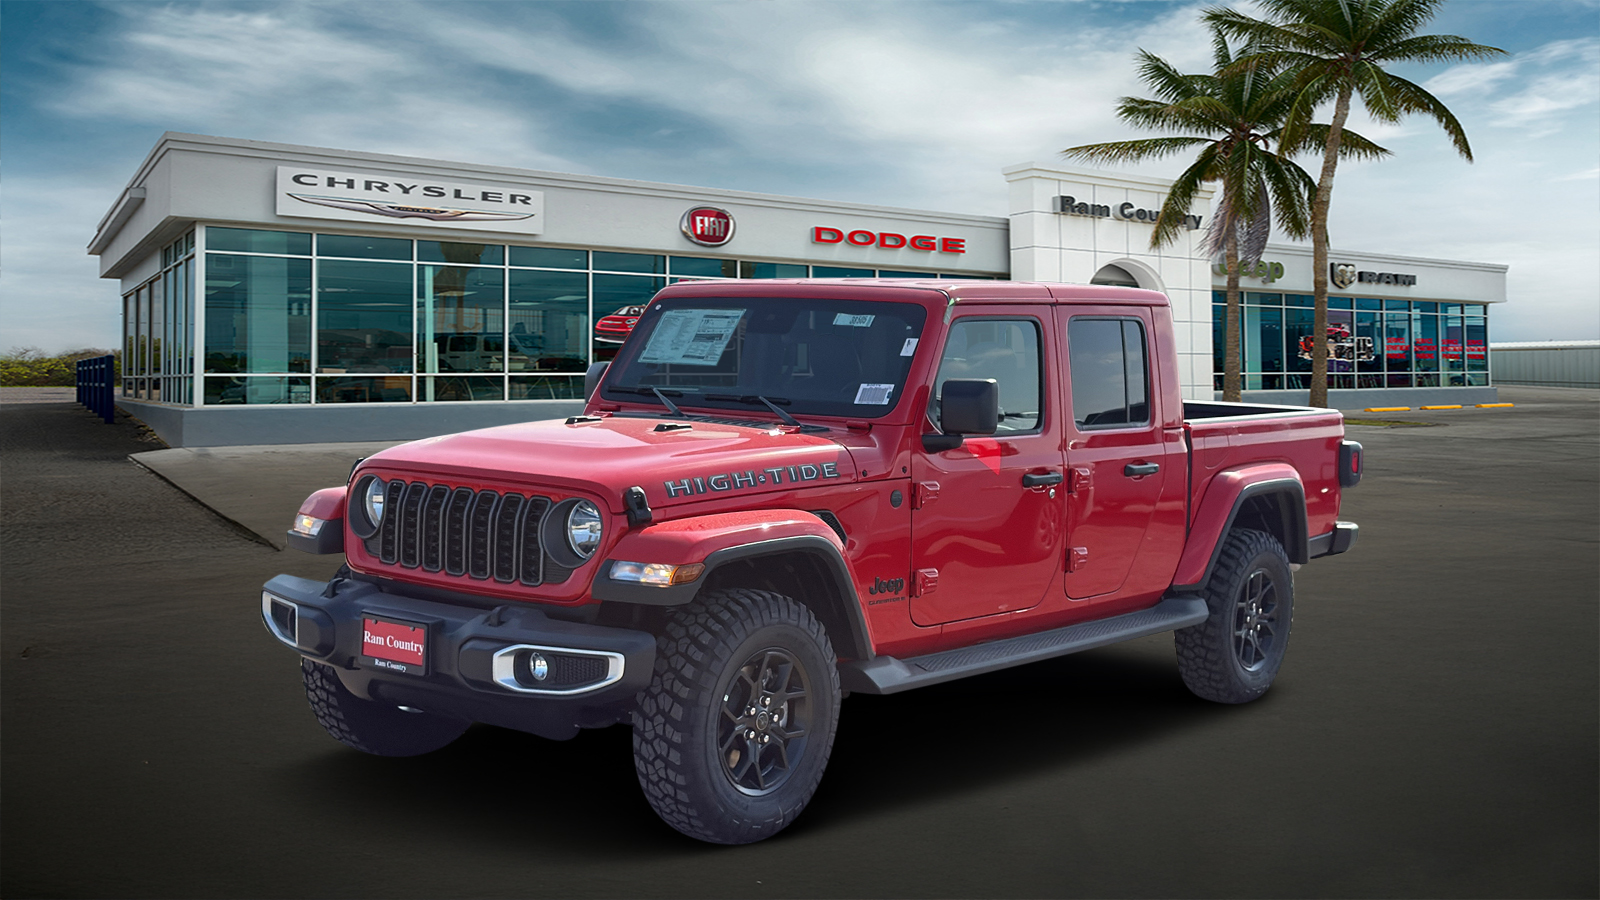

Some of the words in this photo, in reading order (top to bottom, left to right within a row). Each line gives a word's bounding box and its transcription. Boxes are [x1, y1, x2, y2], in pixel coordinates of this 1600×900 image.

[291, 173, 532, 206] CHRYSLER
[1053, 195, 1110, 218] Ram
[694, 215, 728, 237] FIAT
[812, 226, 967, 254] DODGE
[1357, 271, 1416, 286] RAM
[664, 470, 758, 498] HIGH
[764, 462, 841, 485] TIDE
[869, 576, 904, 595] Jeep
[364, 631, 384, 645] Ram
[387, 635, 424, 655] Country
[375, 659, 386, 667] Ram
[387, 661, 406, 672] Country
